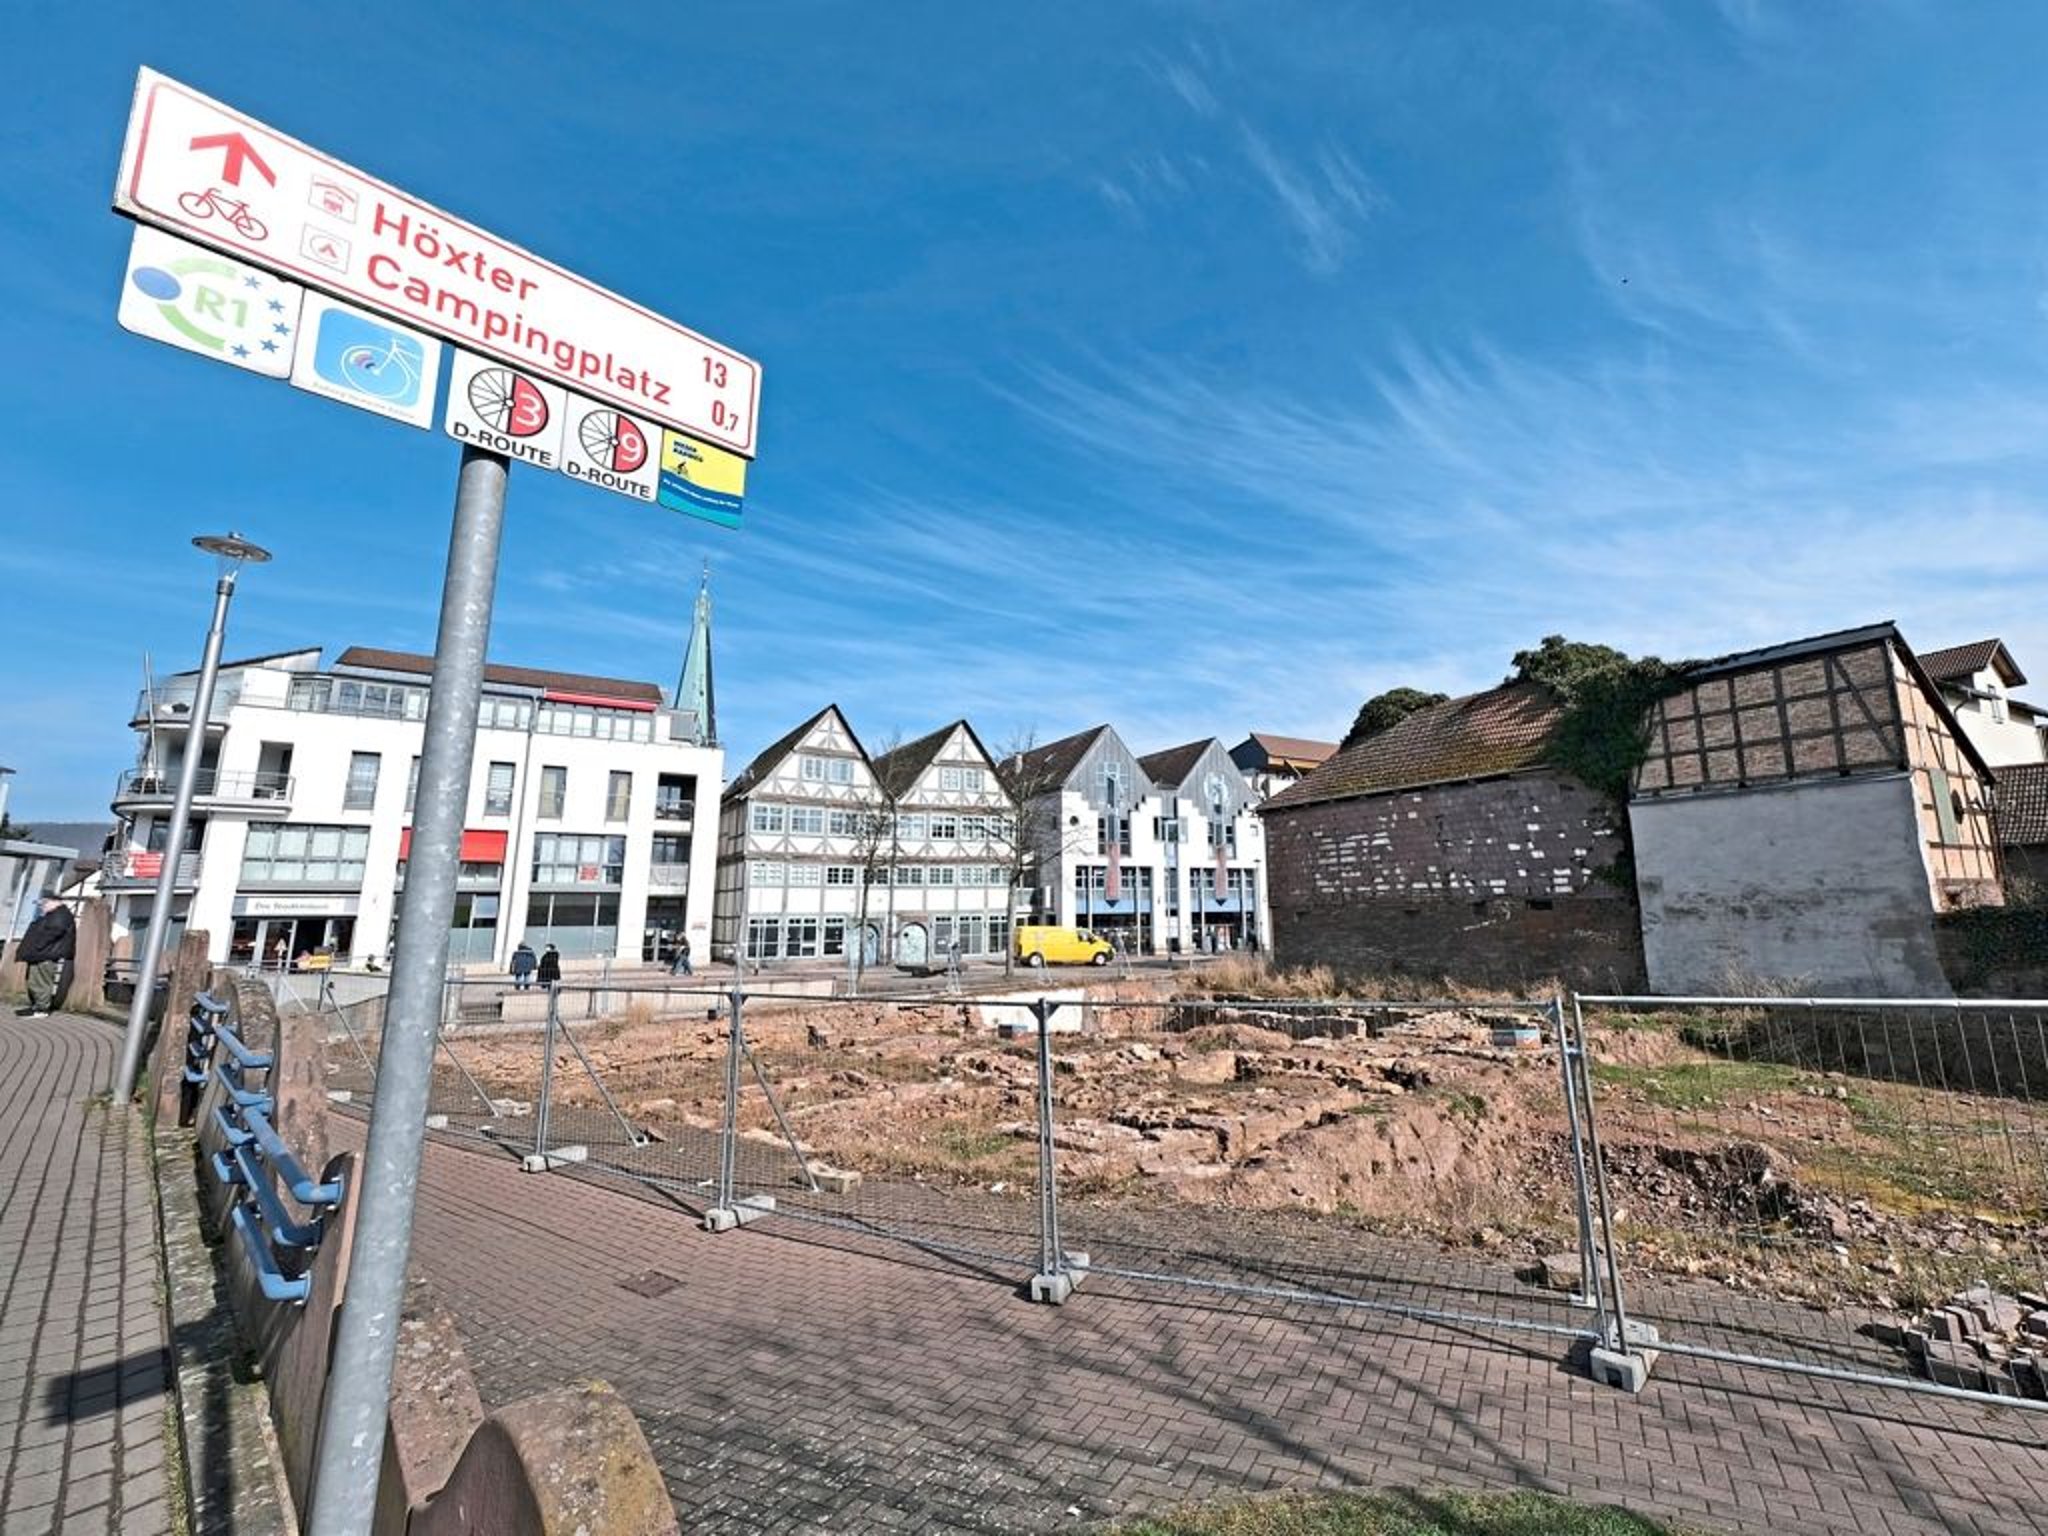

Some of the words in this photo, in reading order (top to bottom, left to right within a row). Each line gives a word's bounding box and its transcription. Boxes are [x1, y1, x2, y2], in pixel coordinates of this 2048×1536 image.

[194, 285, 249, 329] R1
[373, 202, 539, 299] Höxter
[703, 357, 727, 388] 13
[367, 254, 671, 405] Campingplatz
[515, 393, 541, 426] 3
[453, 421, 552, 466] D-ROUTE
[620, 432, 642, 461] 9
[566, 461, 651, 499] D-ROUTE
